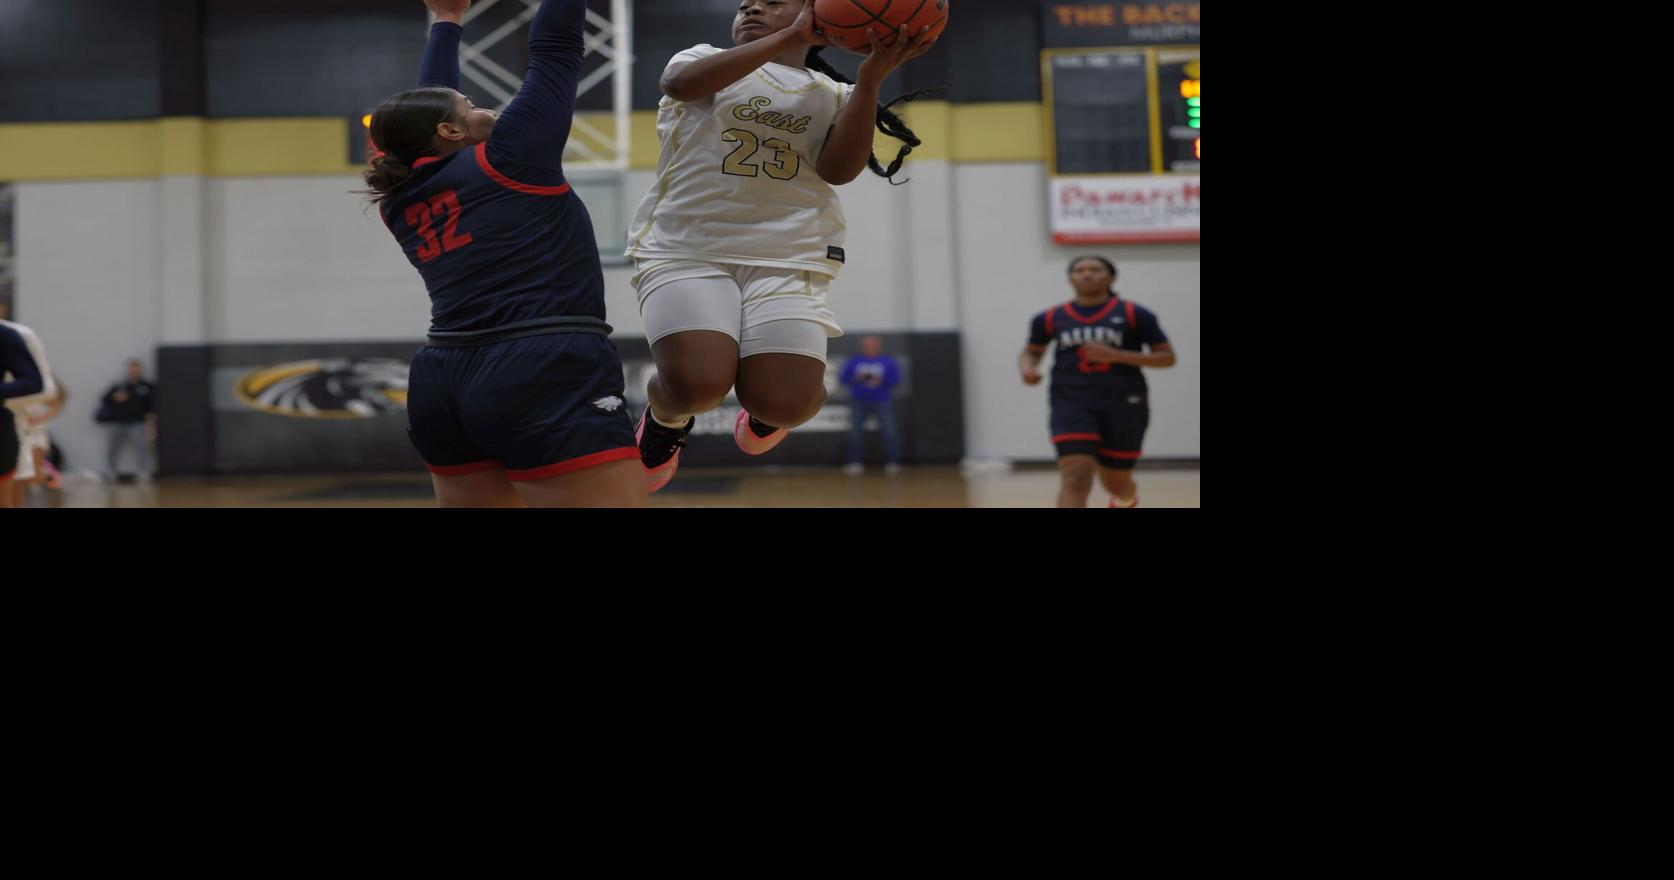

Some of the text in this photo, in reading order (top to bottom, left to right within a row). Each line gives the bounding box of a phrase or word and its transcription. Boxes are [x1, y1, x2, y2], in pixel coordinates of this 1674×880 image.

[1055, 4, 1116, 27] THE
[733, 96, 812, 134] East
[722, 128, 800, 180] 23
[405, 189, 473, 262] 32
